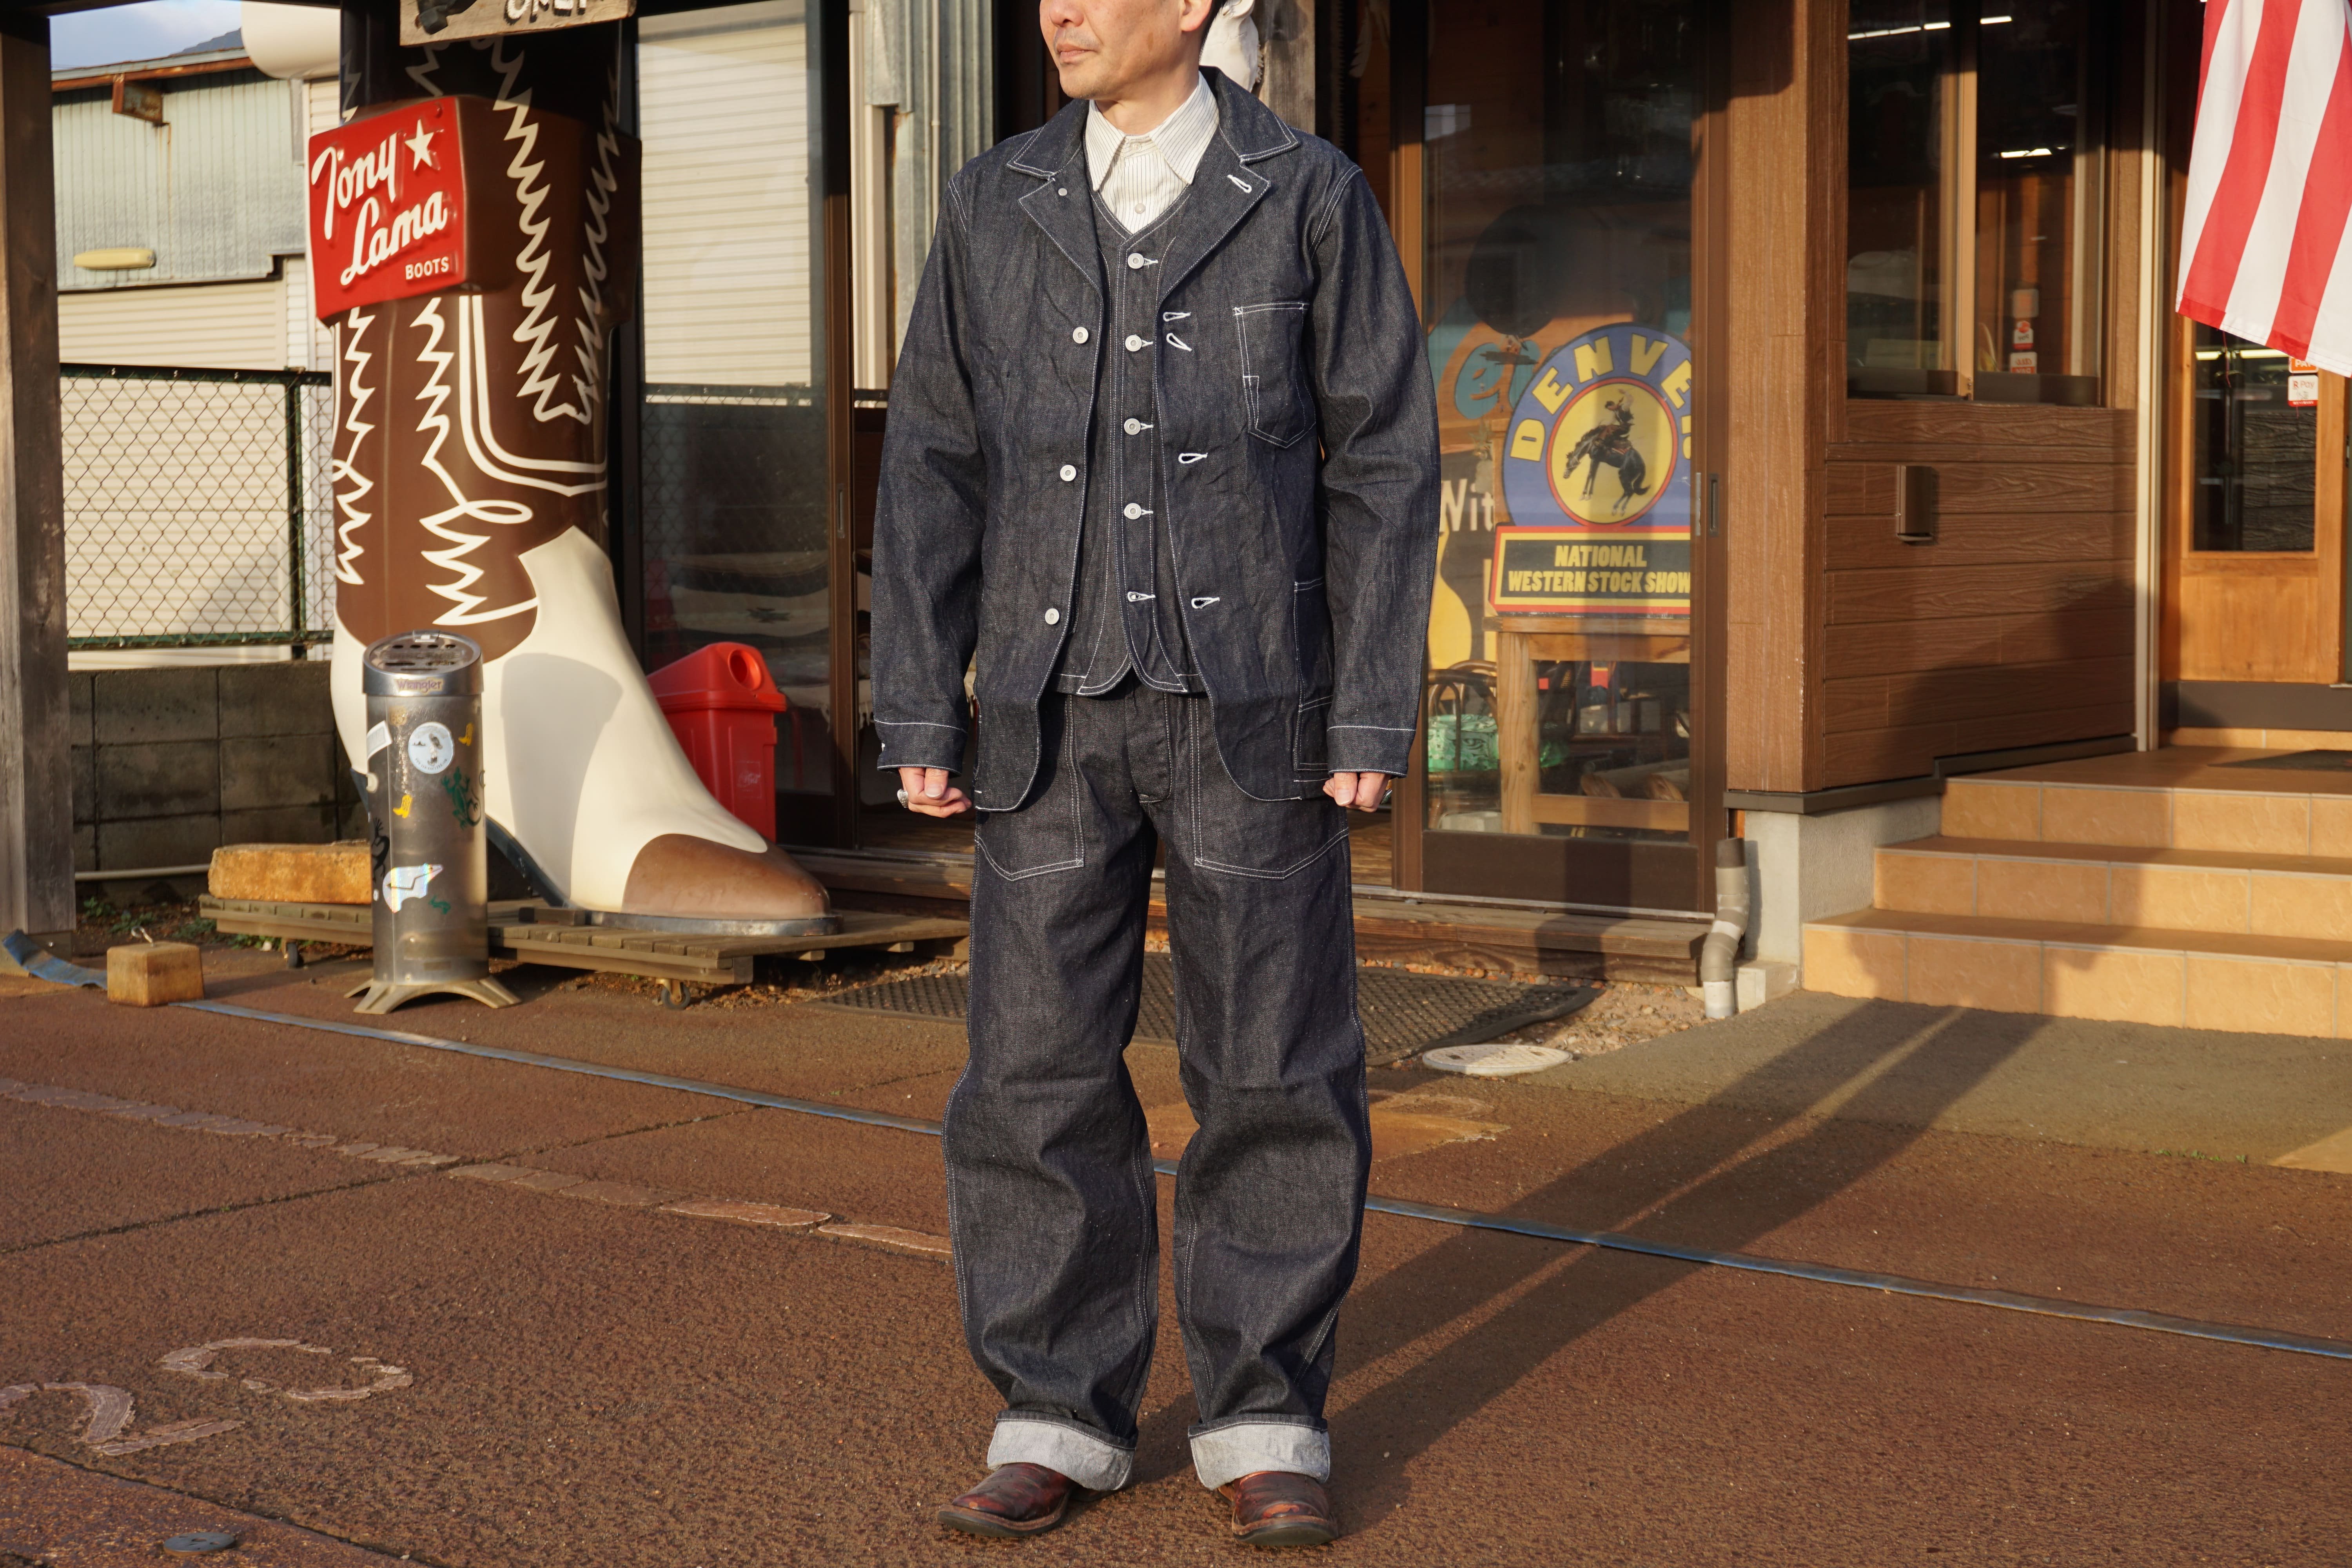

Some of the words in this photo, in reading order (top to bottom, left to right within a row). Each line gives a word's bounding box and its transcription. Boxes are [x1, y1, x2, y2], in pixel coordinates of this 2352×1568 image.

[312, 132, 398, 240] Tony
[341, 191, 448, 286] Lama
[405, 256, 450, 280] BOOTS
[1510, 333, 1691, 462] DENVE
[1555, 545, 1647, 567] NATIONAL
[1508, 570, 1587, 592] WESTERN
[1588, 571, 1644, 593] STOCK
[1645, 572, 1691, 593] SHOW
[396, 679, 442, 693] Wrangler
